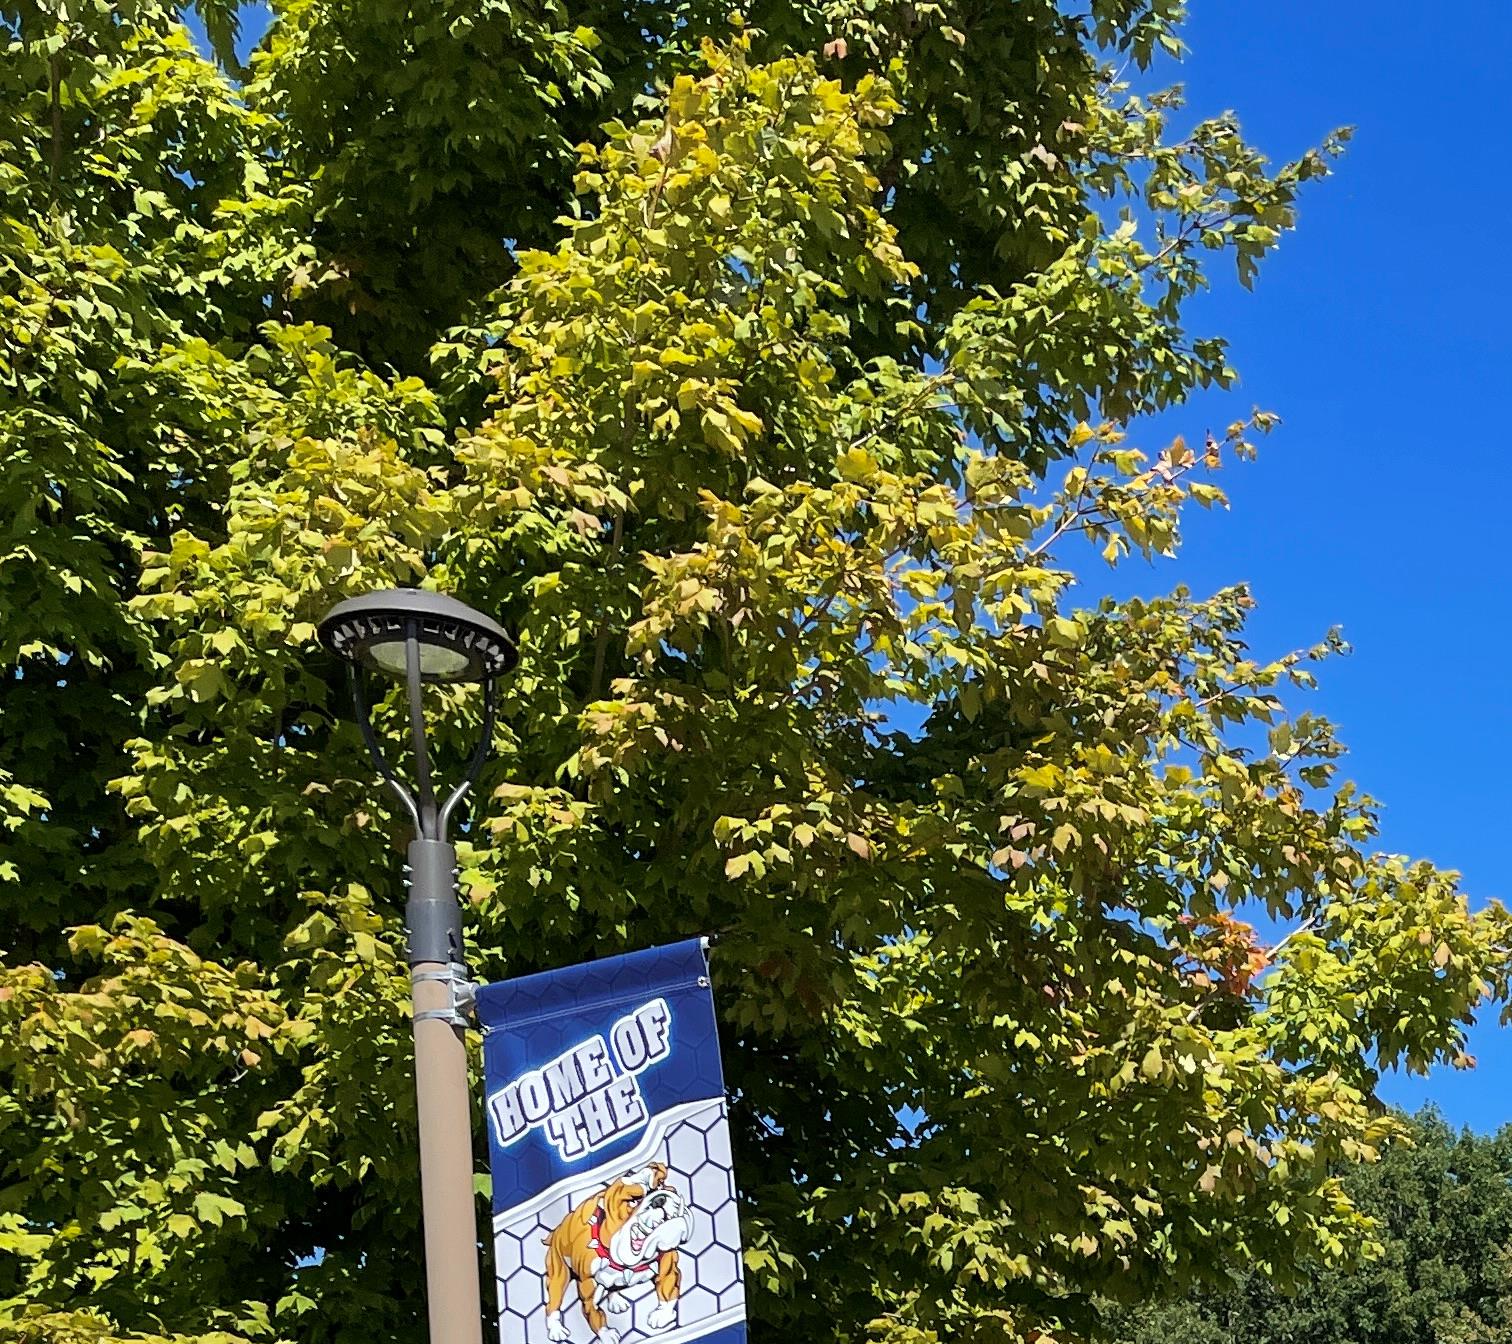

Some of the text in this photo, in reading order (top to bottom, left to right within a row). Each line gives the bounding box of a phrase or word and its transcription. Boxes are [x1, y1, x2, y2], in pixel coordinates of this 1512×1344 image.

[494, 1000, 669, 1145] HOME OF
[549, 1076, 647, 1160] THE
